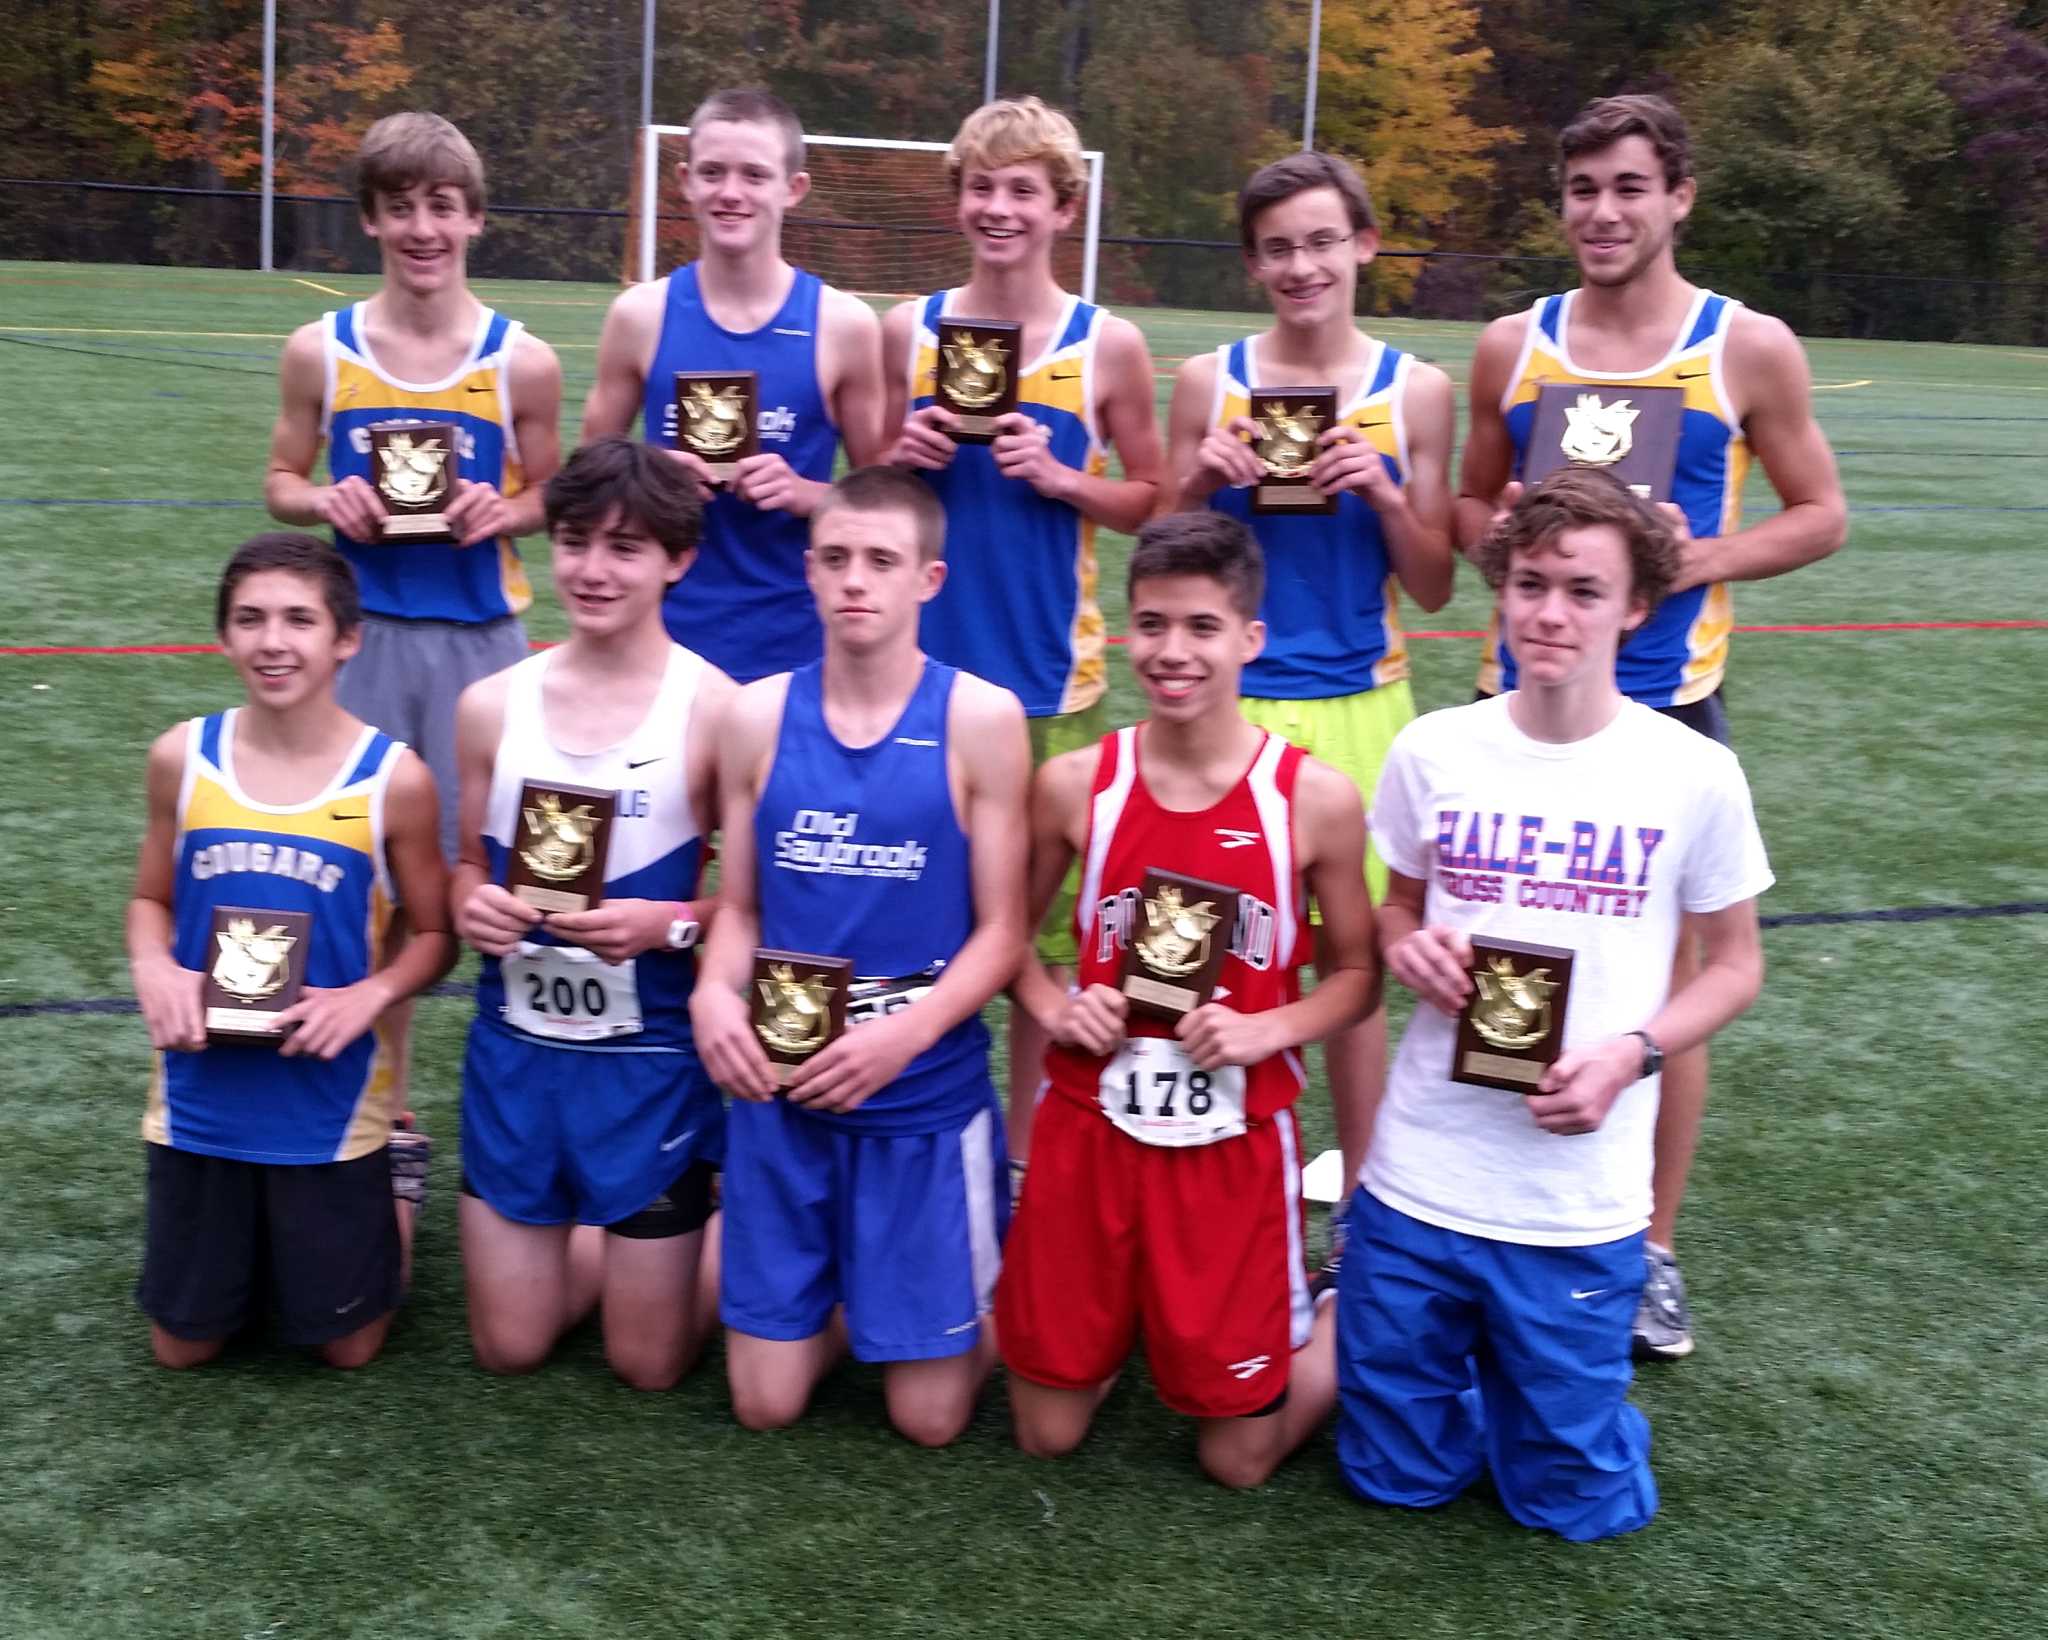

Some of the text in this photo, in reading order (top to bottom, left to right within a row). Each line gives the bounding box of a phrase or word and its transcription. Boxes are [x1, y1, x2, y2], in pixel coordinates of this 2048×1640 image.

[792, 810, 859, 847] Old
[191, 841, 345, 893] COUGARS
[774, 832, 929, 878] Saybrook
[1518, 878, 1650, 919] COUNTRY
[525, 972, 606, 1017] 200
[1126, 1070, 1213, 1117] 178
